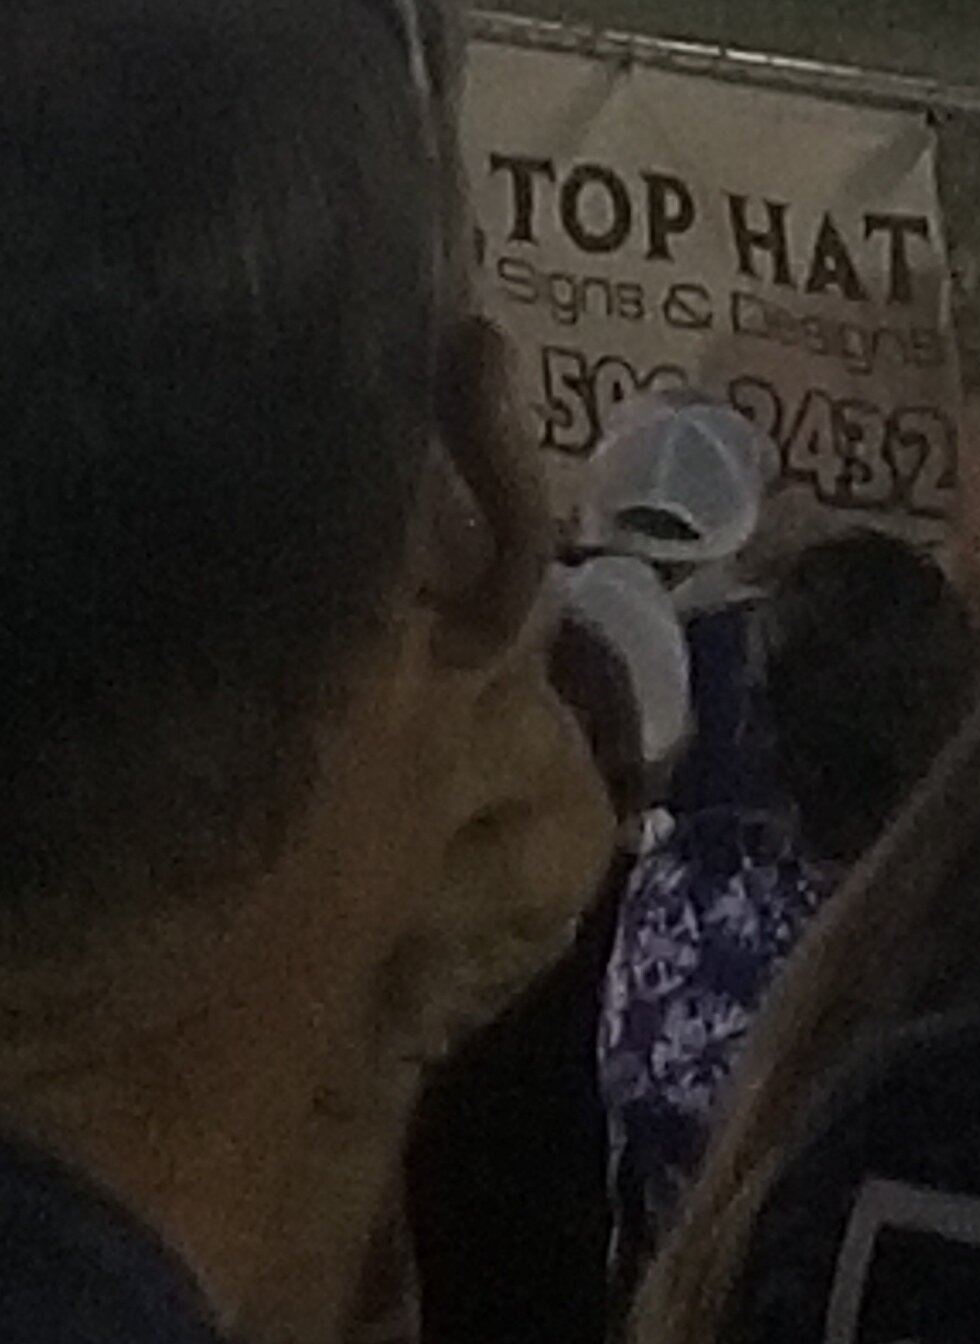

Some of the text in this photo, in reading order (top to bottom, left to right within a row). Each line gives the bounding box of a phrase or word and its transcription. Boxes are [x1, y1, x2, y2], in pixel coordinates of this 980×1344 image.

[489, 151, 931, 305] TOP HAT
[497, 256, 948, 375] Signs & Designs
